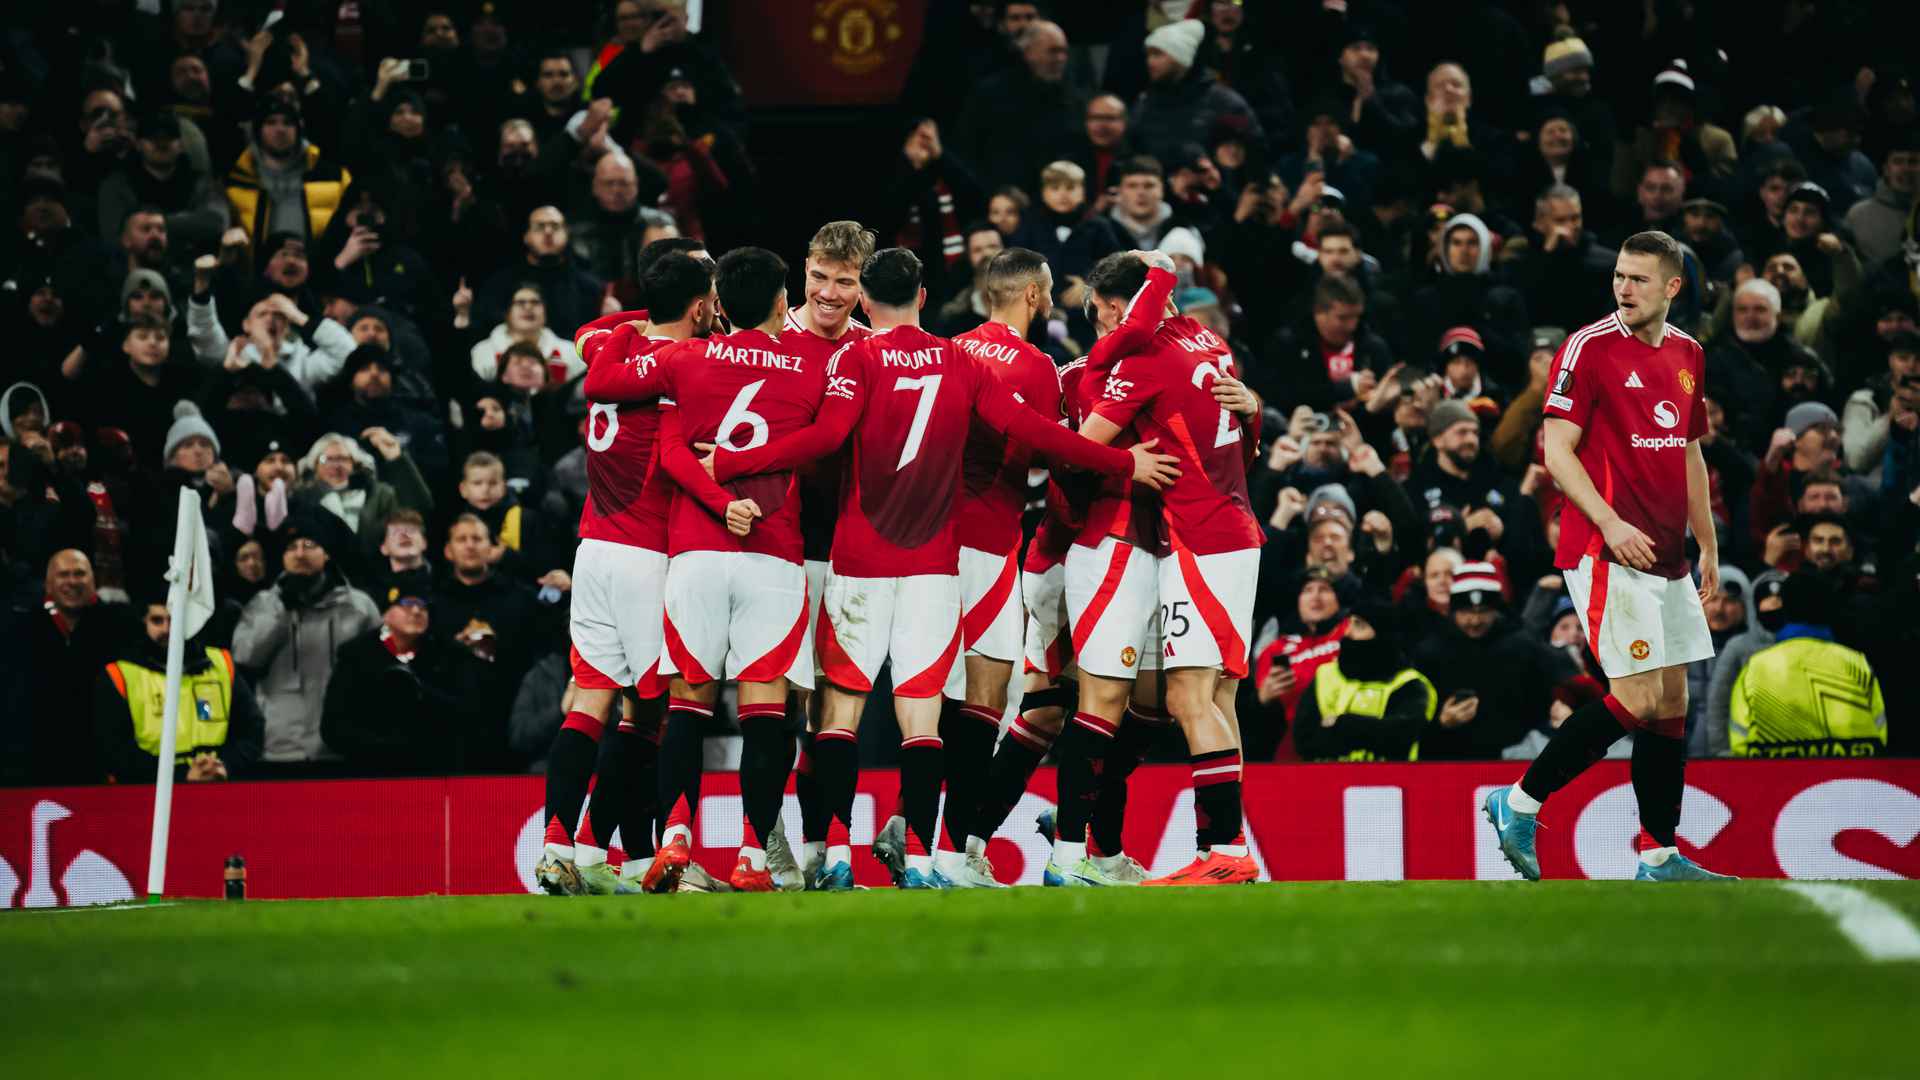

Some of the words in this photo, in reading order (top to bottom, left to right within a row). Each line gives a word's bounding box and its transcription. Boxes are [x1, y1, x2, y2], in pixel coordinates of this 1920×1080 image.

[704, 340, 803, 374] MARTINEZ
[881, 346, 944, 370] MOUNT
[714, 379, 768, 453] 6
[893, 374, 943, 472] 7
[1192, 353, 1243, 449] 2
